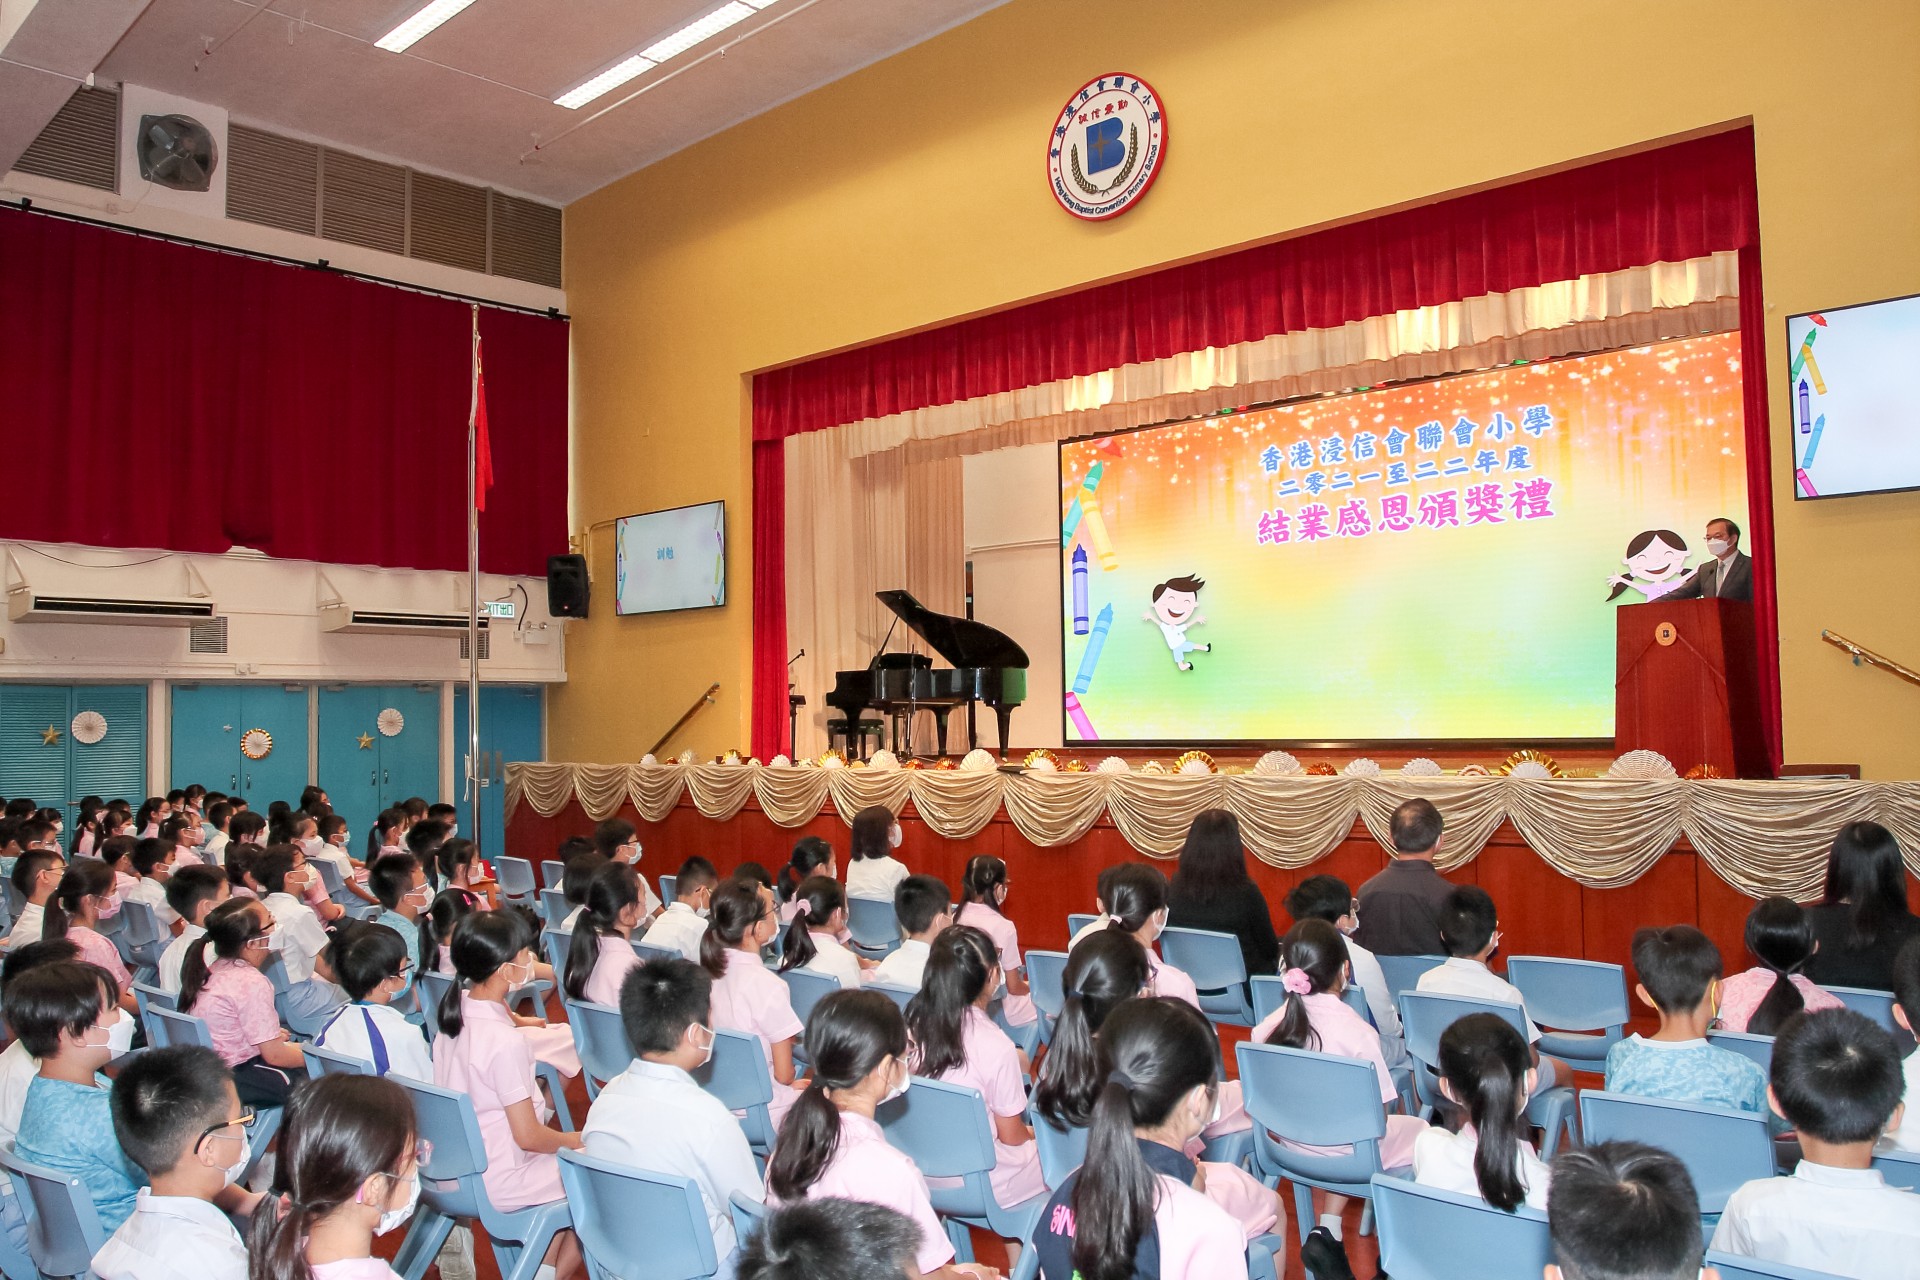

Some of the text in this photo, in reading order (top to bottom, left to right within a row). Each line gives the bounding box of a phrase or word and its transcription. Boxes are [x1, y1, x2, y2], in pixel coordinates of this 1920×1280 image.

[1054, 144, 1158, 214] Hong Kong Baptist Convention Primary School
[1086, 117, 1125, 176] B
[1260, 405, 1552, 472] 香港浸信會聯會小學
[1278, 446, 1532, 496] 二零二一至二二年度
[1258, 477, 1555, 544] 結業感恩頒獎禮
